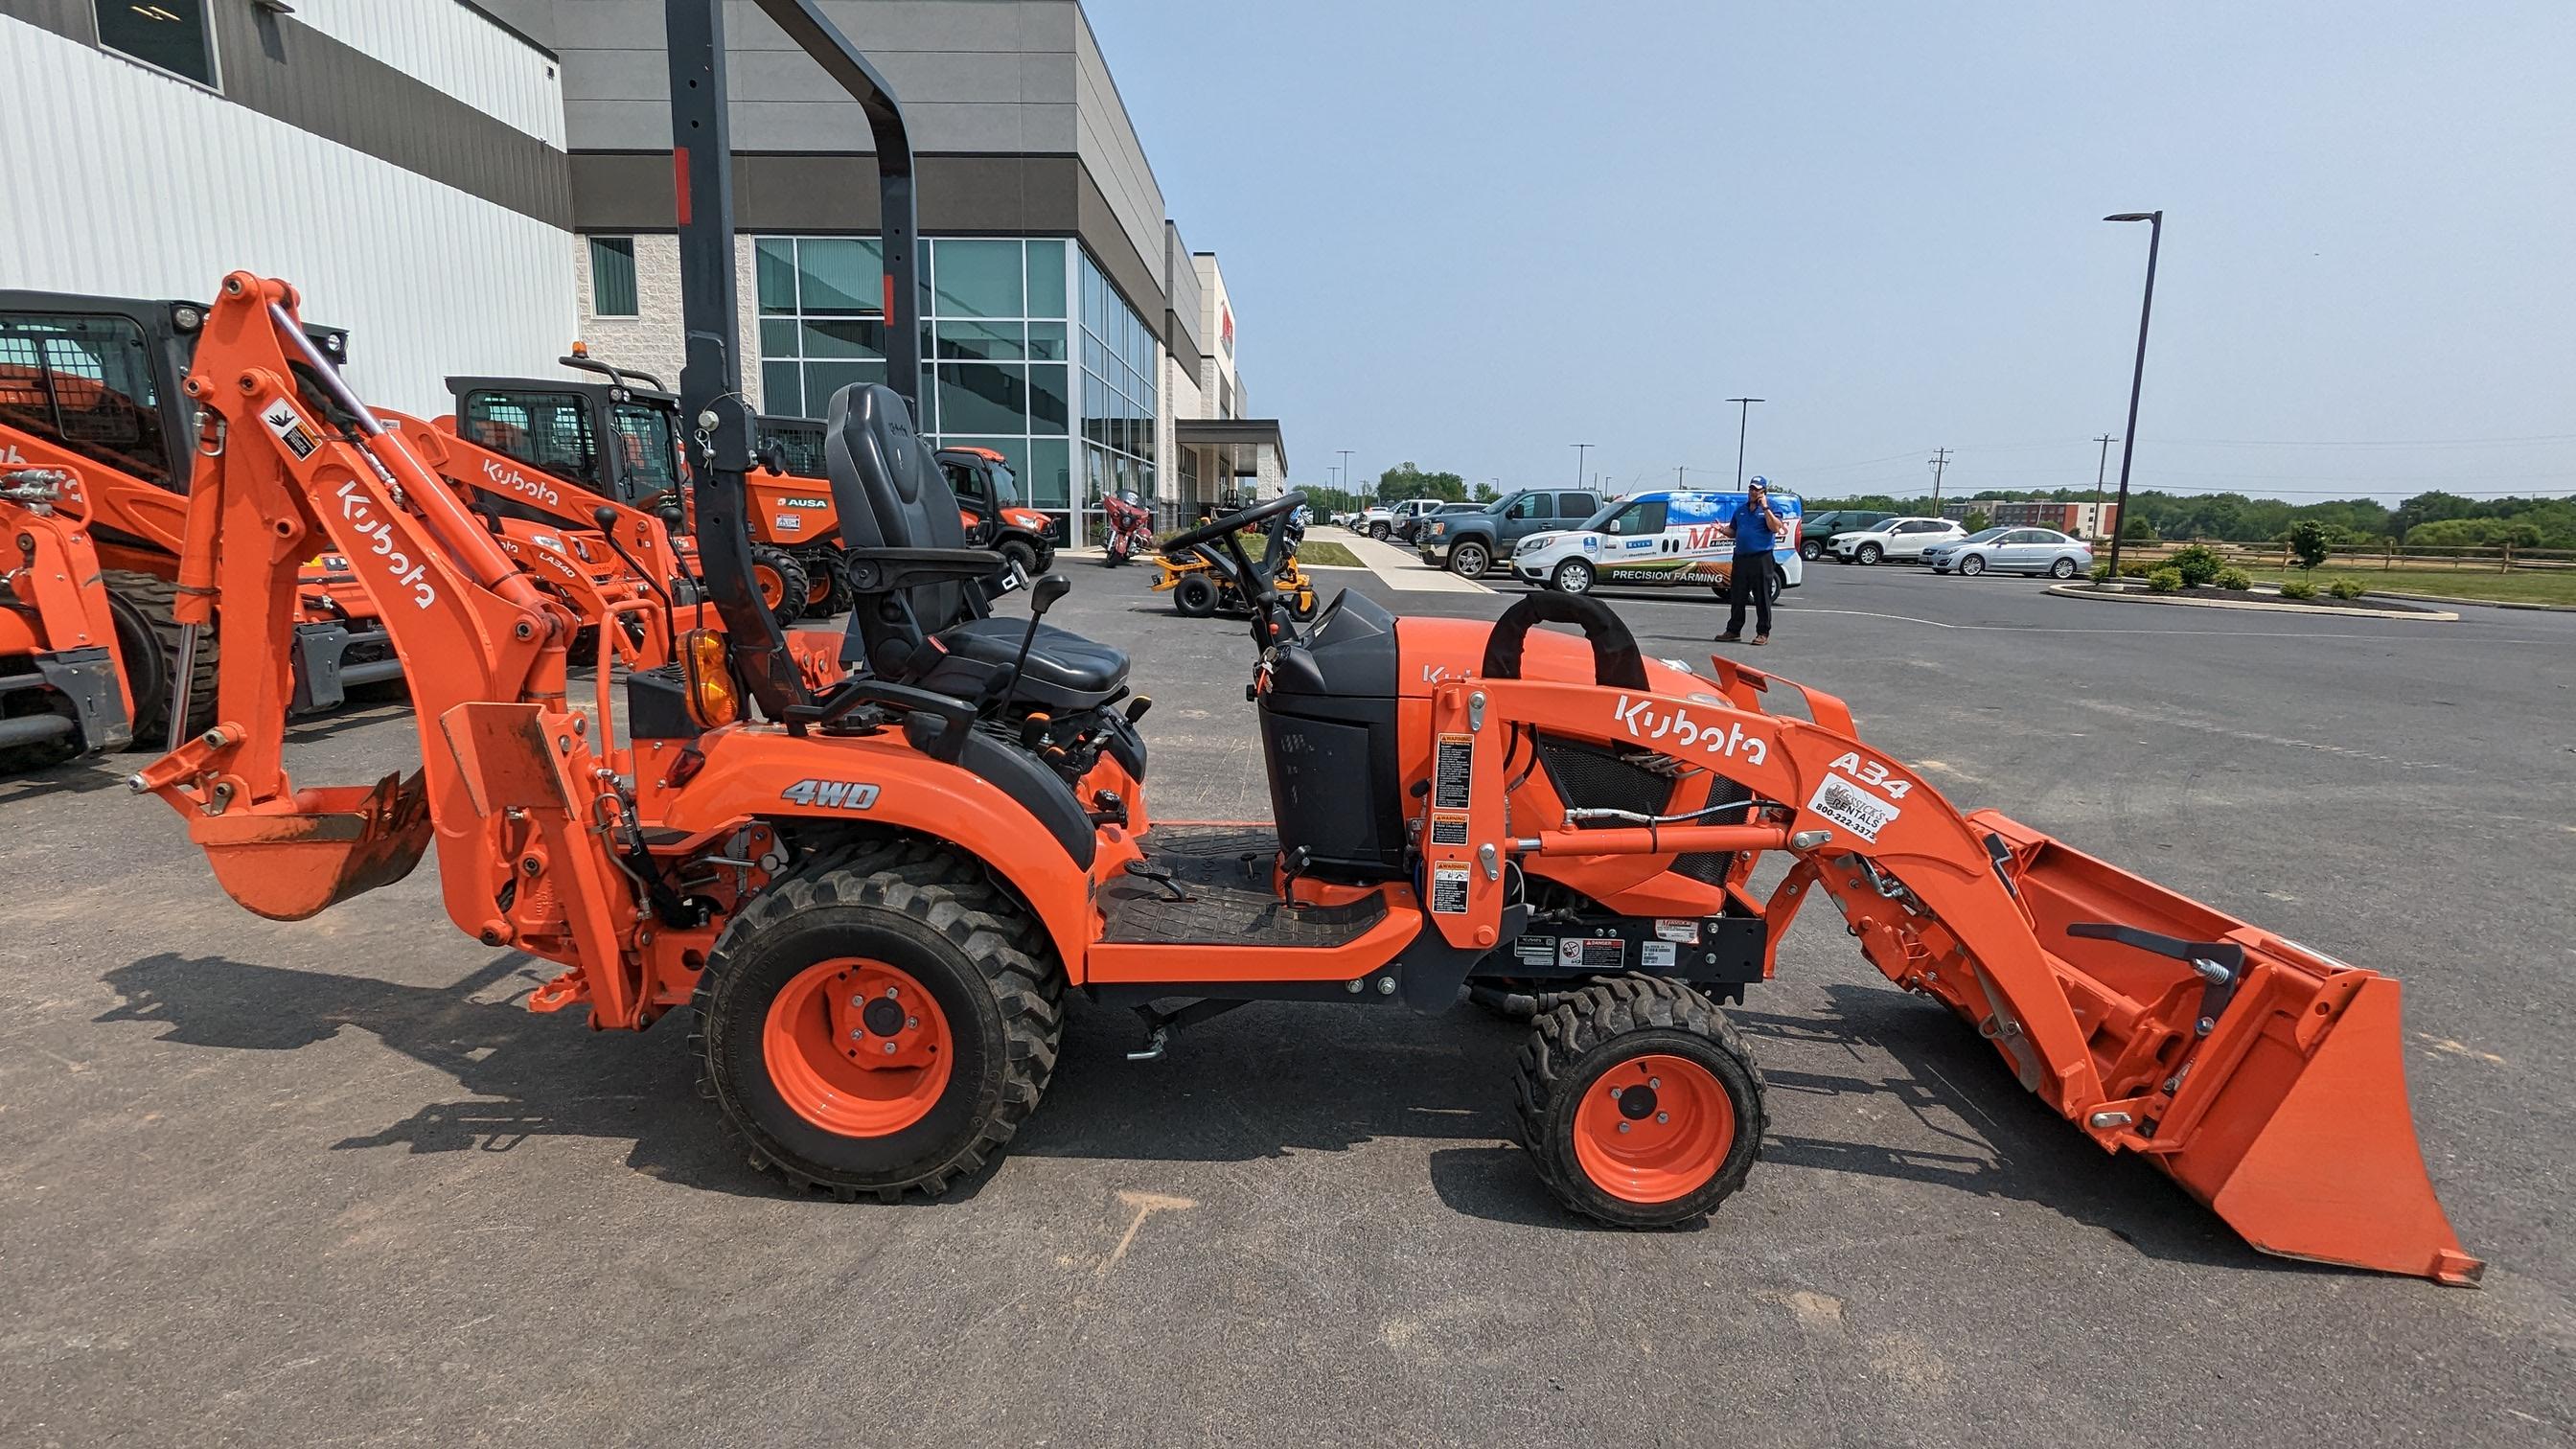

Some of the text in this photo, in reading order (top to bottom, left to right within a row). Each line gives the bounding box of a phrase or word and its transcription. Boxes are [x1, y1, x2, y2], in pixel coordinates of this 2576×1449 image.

[483, 459, 559, 506] Kubota
[788, 499, 827, 508] AUSA
[336, 480, 435, 610] Kubota
[539, 552, 576, 578] LA340
[1612, 570, 1723, 583] PRECISION FARMING
[1614, 695, 1767, 766] Kubota
[1828, 751, 1913, 799] A34
[781, 778, 881, 810] 4WD
[1815, 803, 1876, 840] 800-222-3373
[1832, 798, 1879, 828] RENTALS
